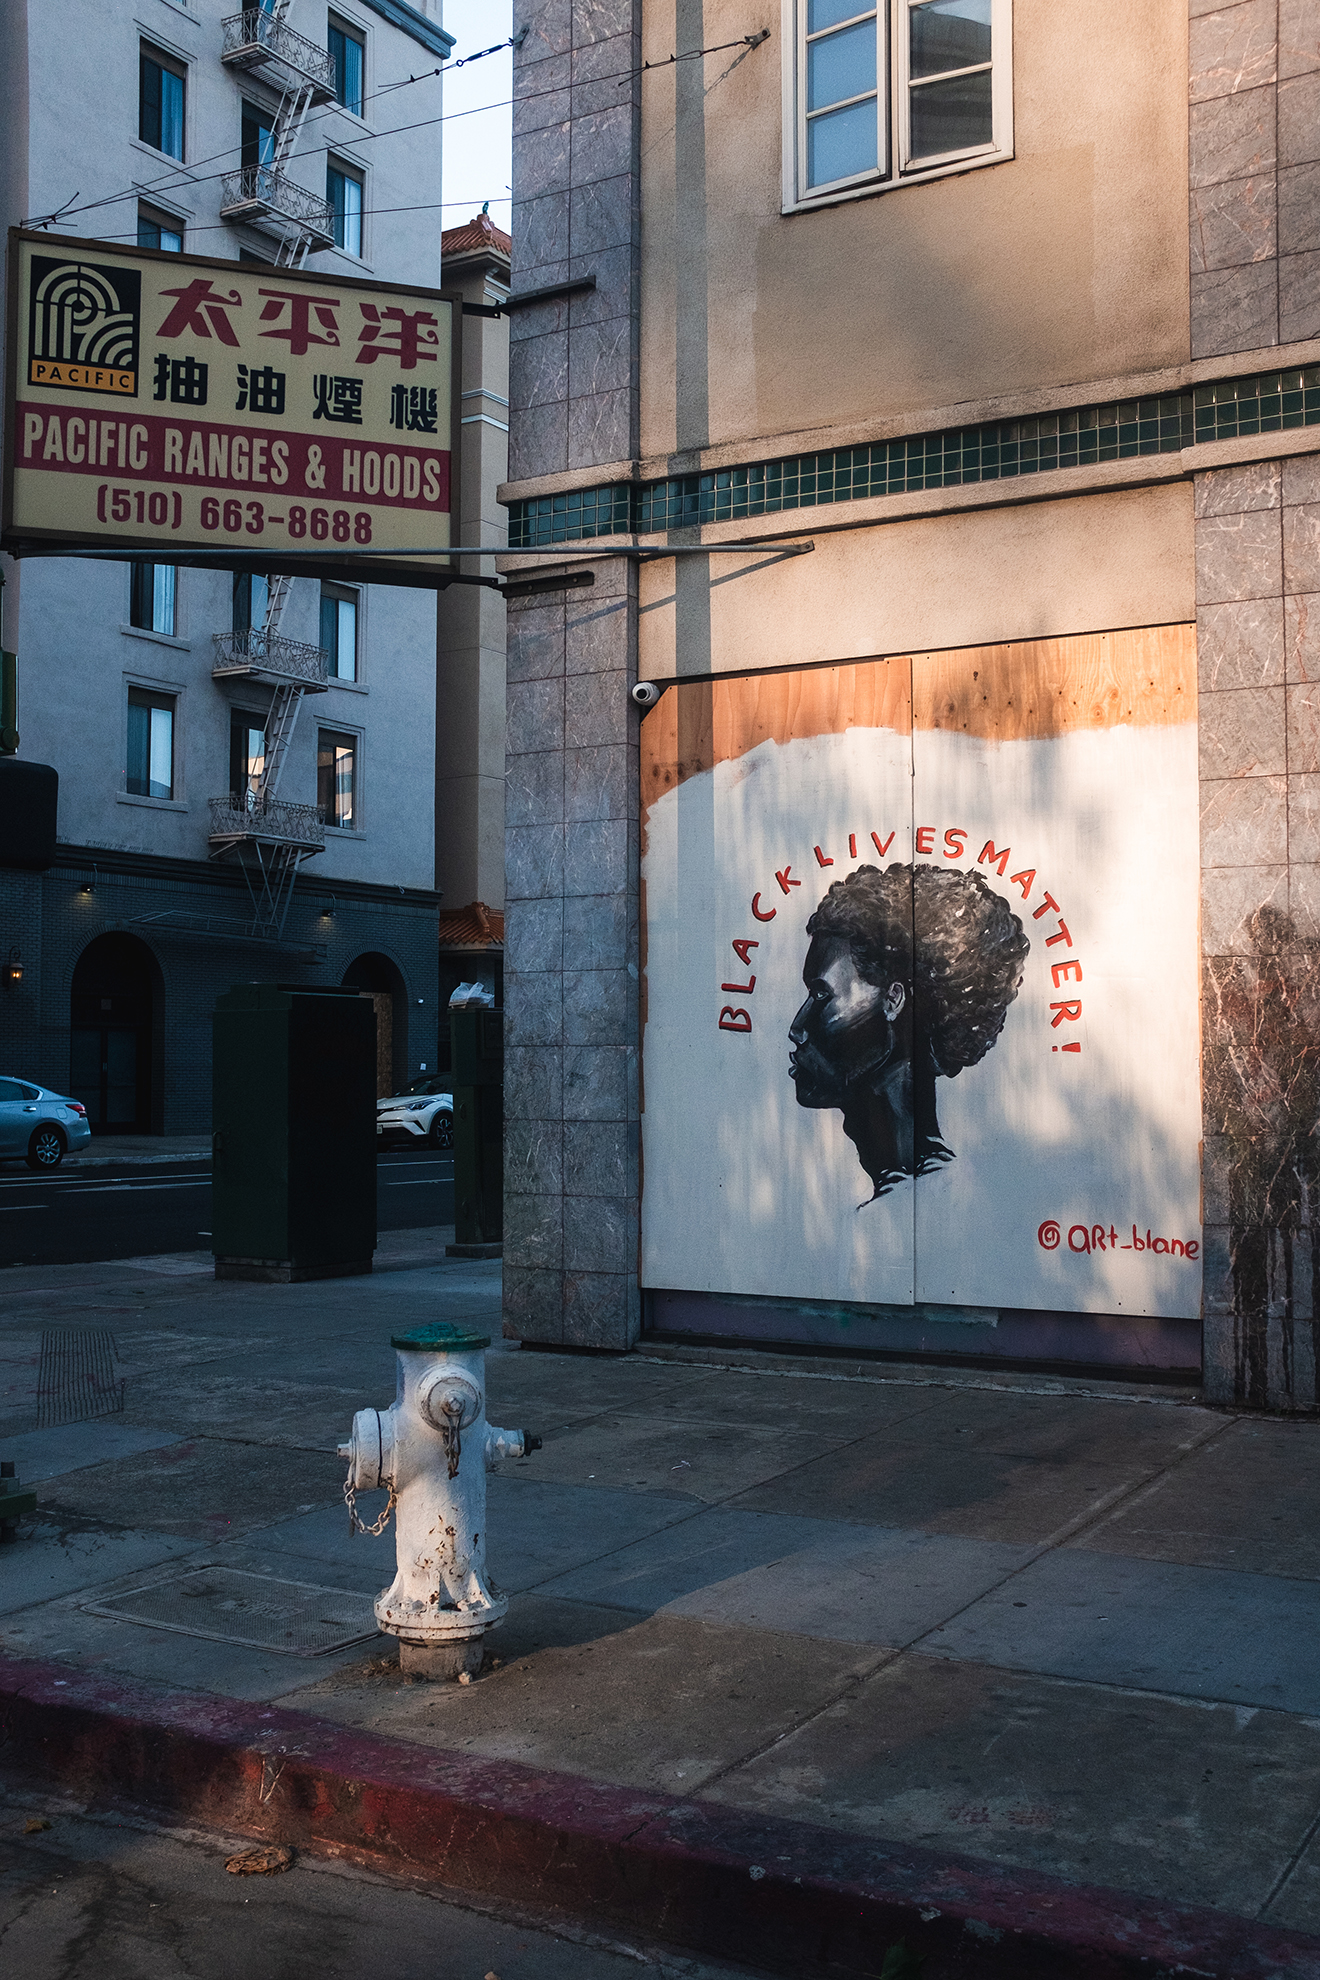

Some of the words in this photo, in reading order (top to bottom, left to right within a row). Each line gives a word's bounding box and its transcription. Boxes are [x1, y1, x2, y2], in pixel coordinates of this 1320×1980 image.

[155, 278, 440, 370] 太平洋
[35, 364, 131, 389] PACIFIC
[153, 353, 438, 434] 抽油煙機
[23, 412, 149, 470] PACIFIC
[164, 428, 290, 486] RANGES
[304, 444, 326, 489] &
[342, 448, 441, 502] HOODS
[97, 484, 182, 530] (510)
[199, 497, 373, 544] 663-8688
[718, 865, 802, 1033] BLACK
[813, 826, 969, 869] LIVES
[977, 839, 1084, 1054] MATTER!
